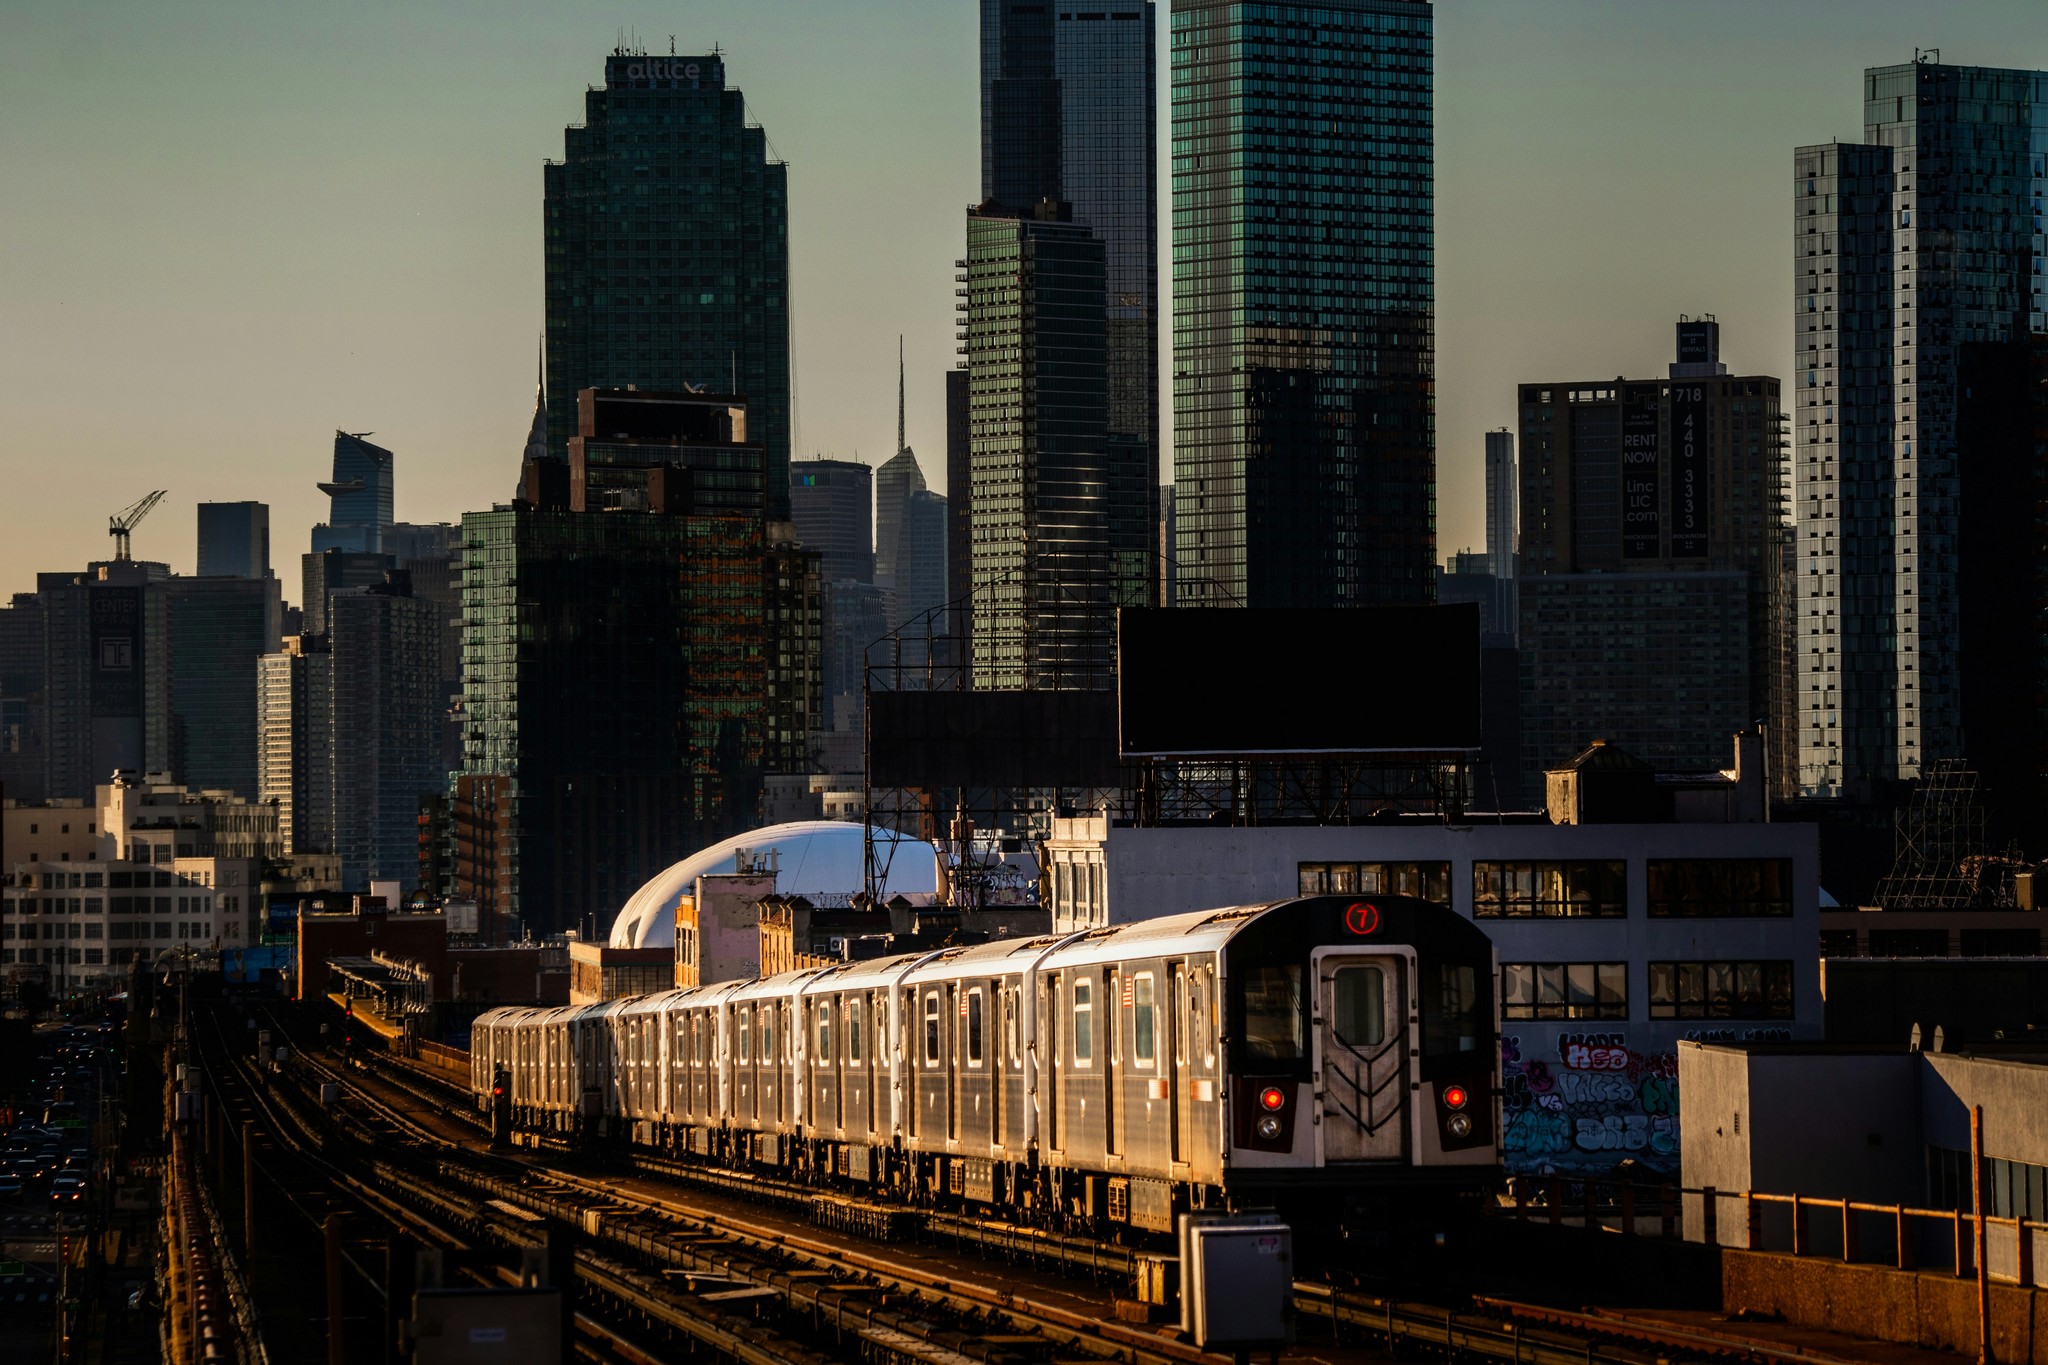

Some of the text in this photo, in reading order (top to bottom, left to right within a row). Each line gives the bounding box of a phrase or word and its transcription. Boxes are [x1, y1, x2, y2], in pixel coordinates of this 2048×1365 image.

[627, 58, 700, 80] altice
[1675, 387, 1702, 402] 718
[1624, 434, 1656, 447] RENT
[1624, 451, 1657, 463] NOW
[1627, 480, 1654, 492] Linc
[1630, 495, 1651, 507] LIC
[1624, 511, 1658, 522] .com
[94, 599, 136, 612] CENTER
